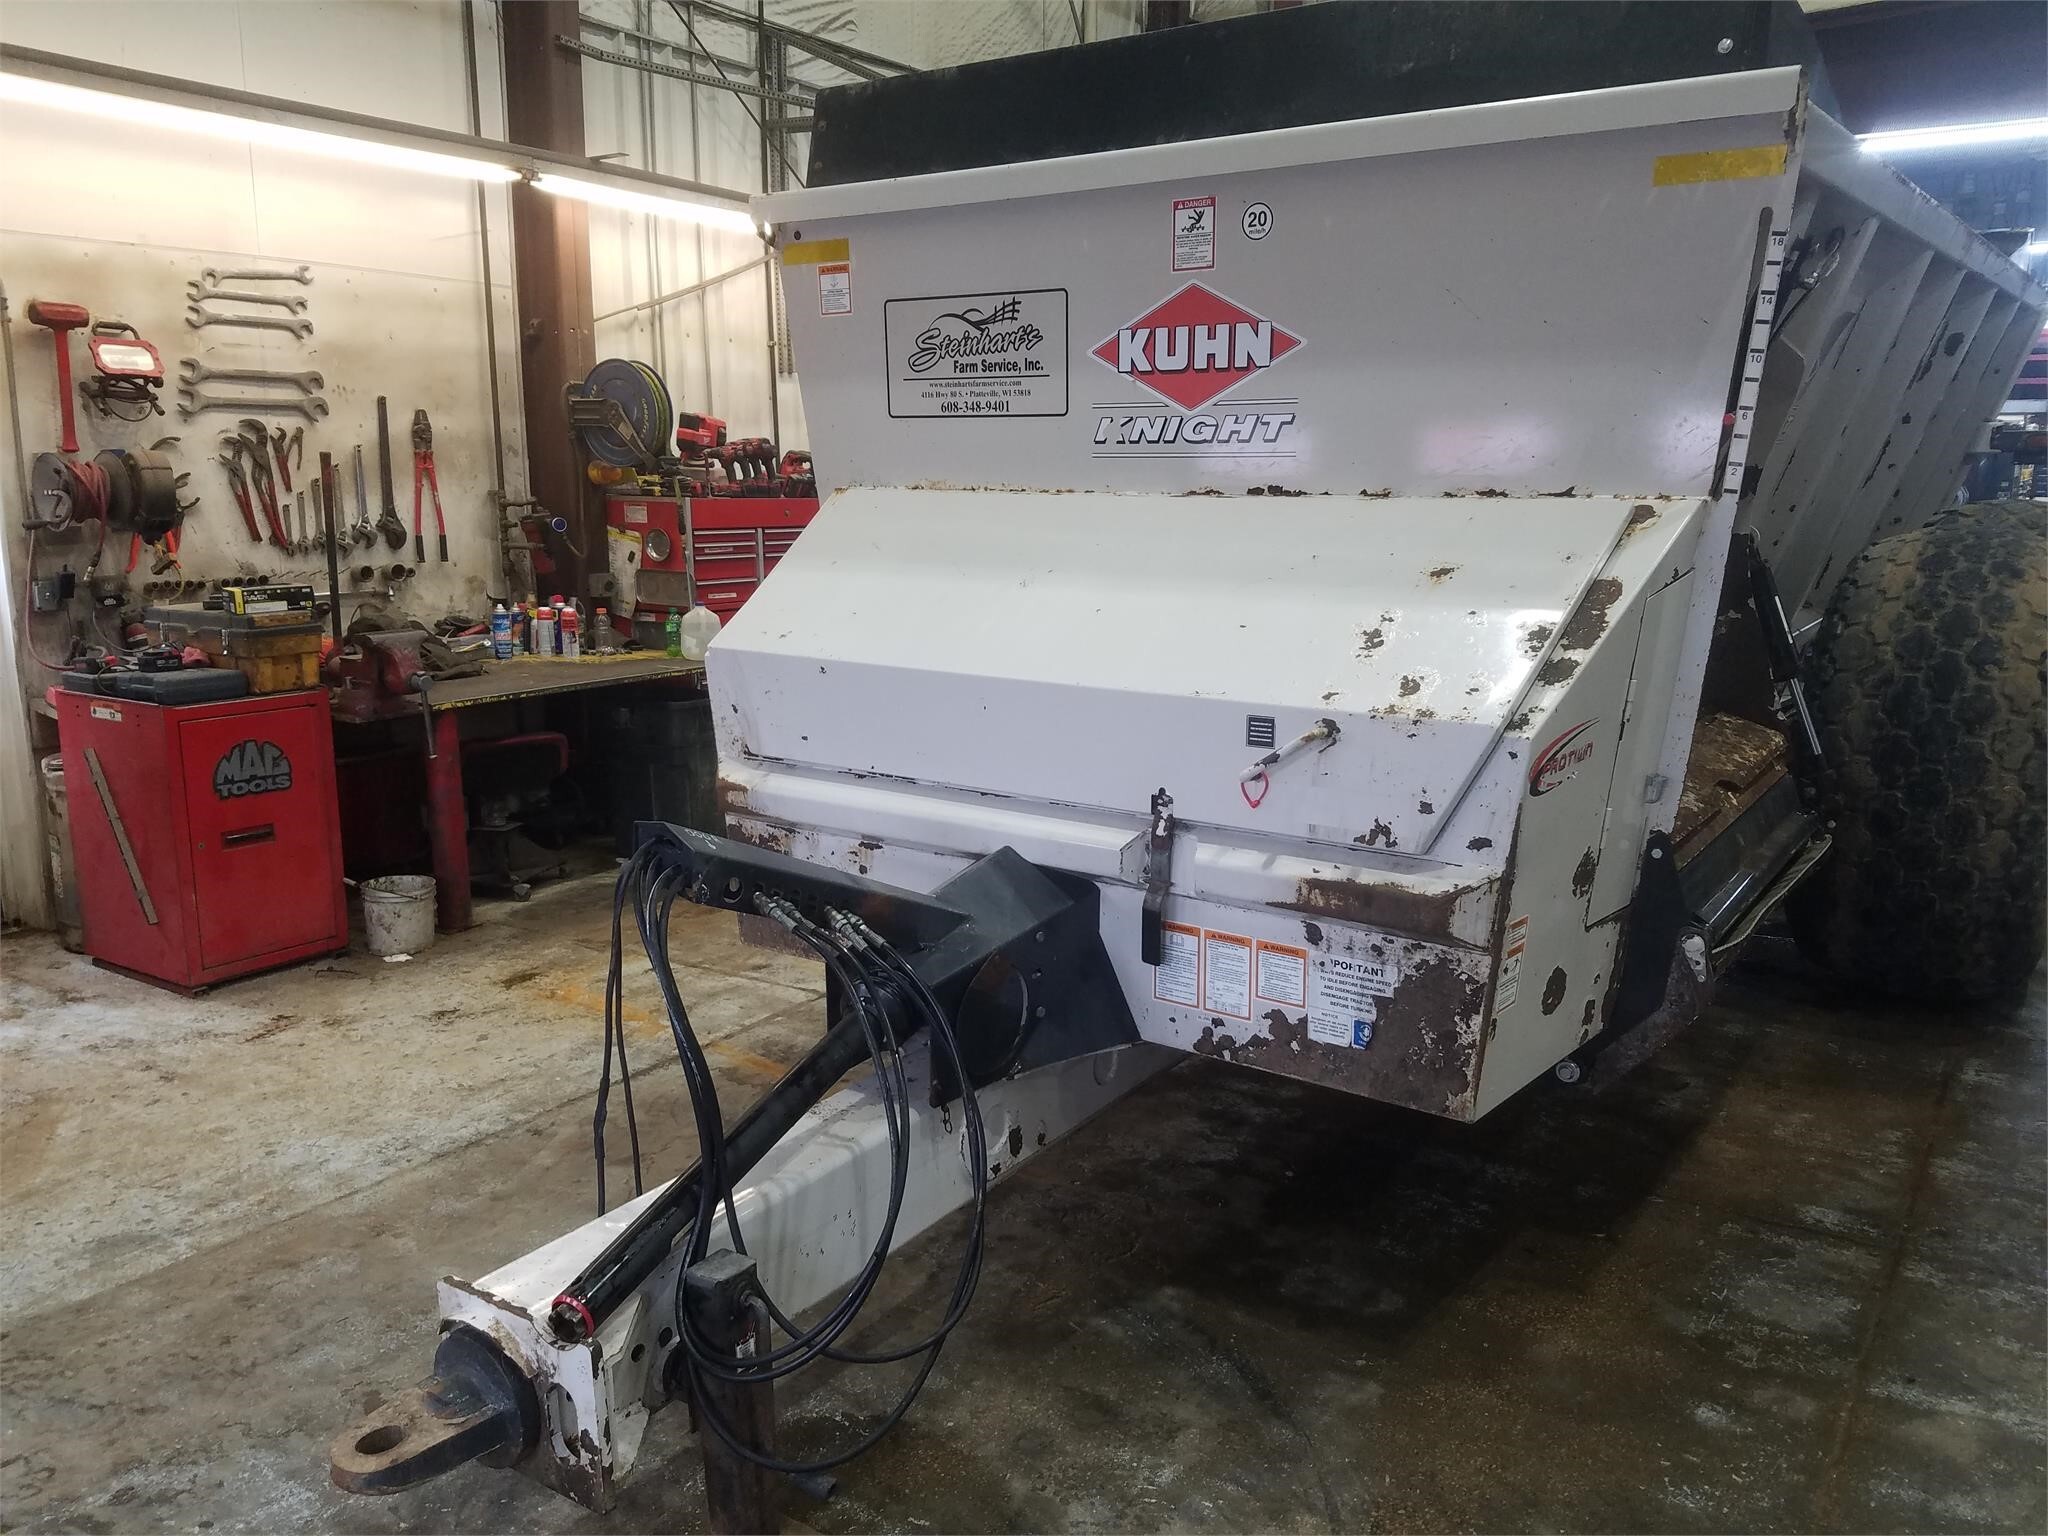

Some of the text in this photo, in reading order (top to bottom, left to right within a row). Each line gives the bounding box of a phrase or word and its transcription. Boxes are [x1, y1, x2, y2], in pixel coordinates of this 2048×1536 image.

[1184, 199, 1212, 208] DANGER
[1247, 210, 1268, 228] 20
[1771, 237, 1784, 246] 18
[1760, 296, 1773, 305] 14
[908, 323, 1044, 373] Steinhart's
[1117, 320, 1272, 374] KUHN
[1750, 354, 1763, 364] 10
[953, 357, 1044, 374] Farm Service, Inc.
[929, 380, 1022, 388] www.steinhartsfarmservice.com
[935, 390, 949, 399] Hwy
[1002, 389, 1012, 397] WI
[1012, 389, 1031, 397] 53818
[940, 400, 1010, 413] 608-348-9401
[1741, 411, 1748, 421] 6
[1092, 413, 1297, 446] KNIGHT
[1730, 467, 1738, 476] 2
[216, 739, 291, 785] MAC
[216, 775, 291, 798] TOOLS
[1167, 923, 1194, 934] WARNING
[1217, 933, 1246, 944] WARNING
[1269, 944, 1300, 956] WARNING
[1330, 958, 1384, 977] PORTANT
[1375, 980, 1392, 988] SPEED
